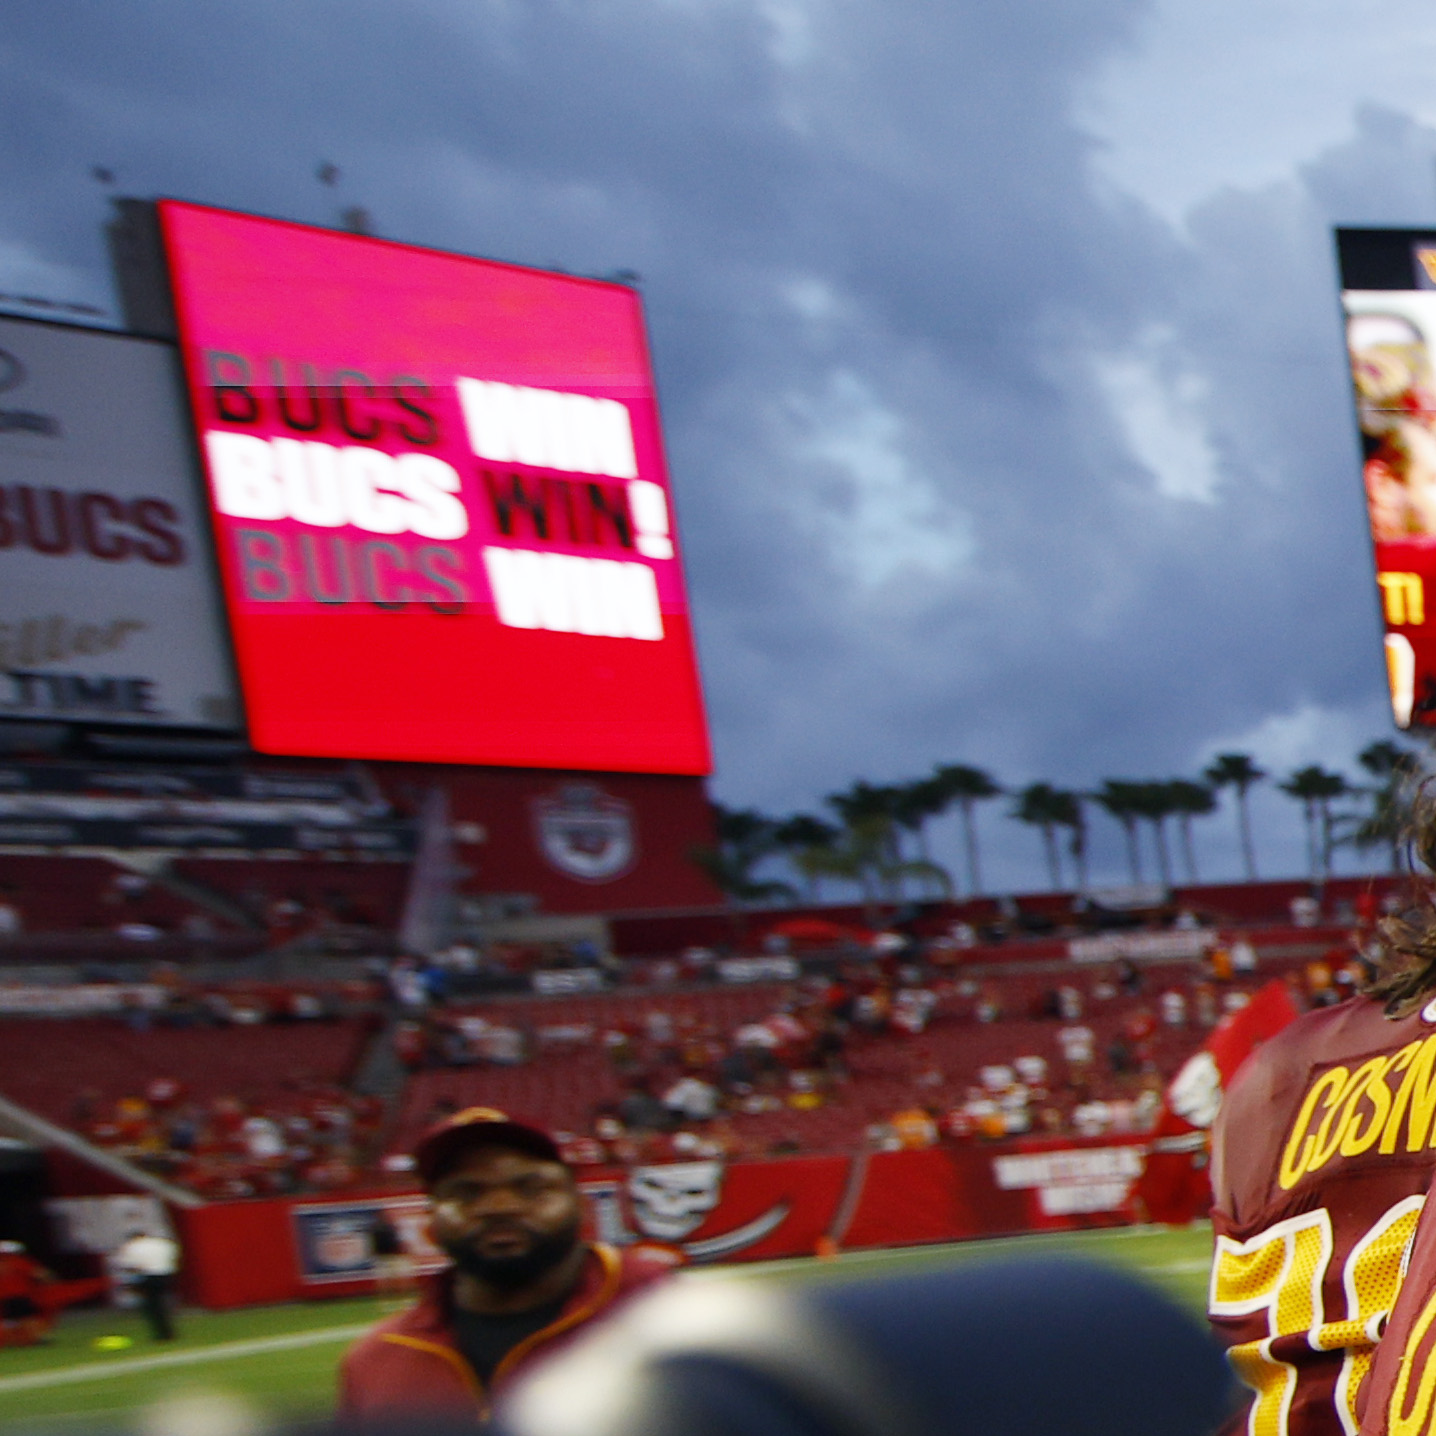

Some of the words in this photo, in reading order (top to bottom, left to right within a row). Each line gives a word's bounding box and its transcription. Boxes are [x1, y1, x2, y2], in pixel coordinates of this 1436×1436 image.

[205, 348, 440, 447] BUCS
[205, 430, 469, 540] BUCS
[237, 528, 468, 616] BUCS
